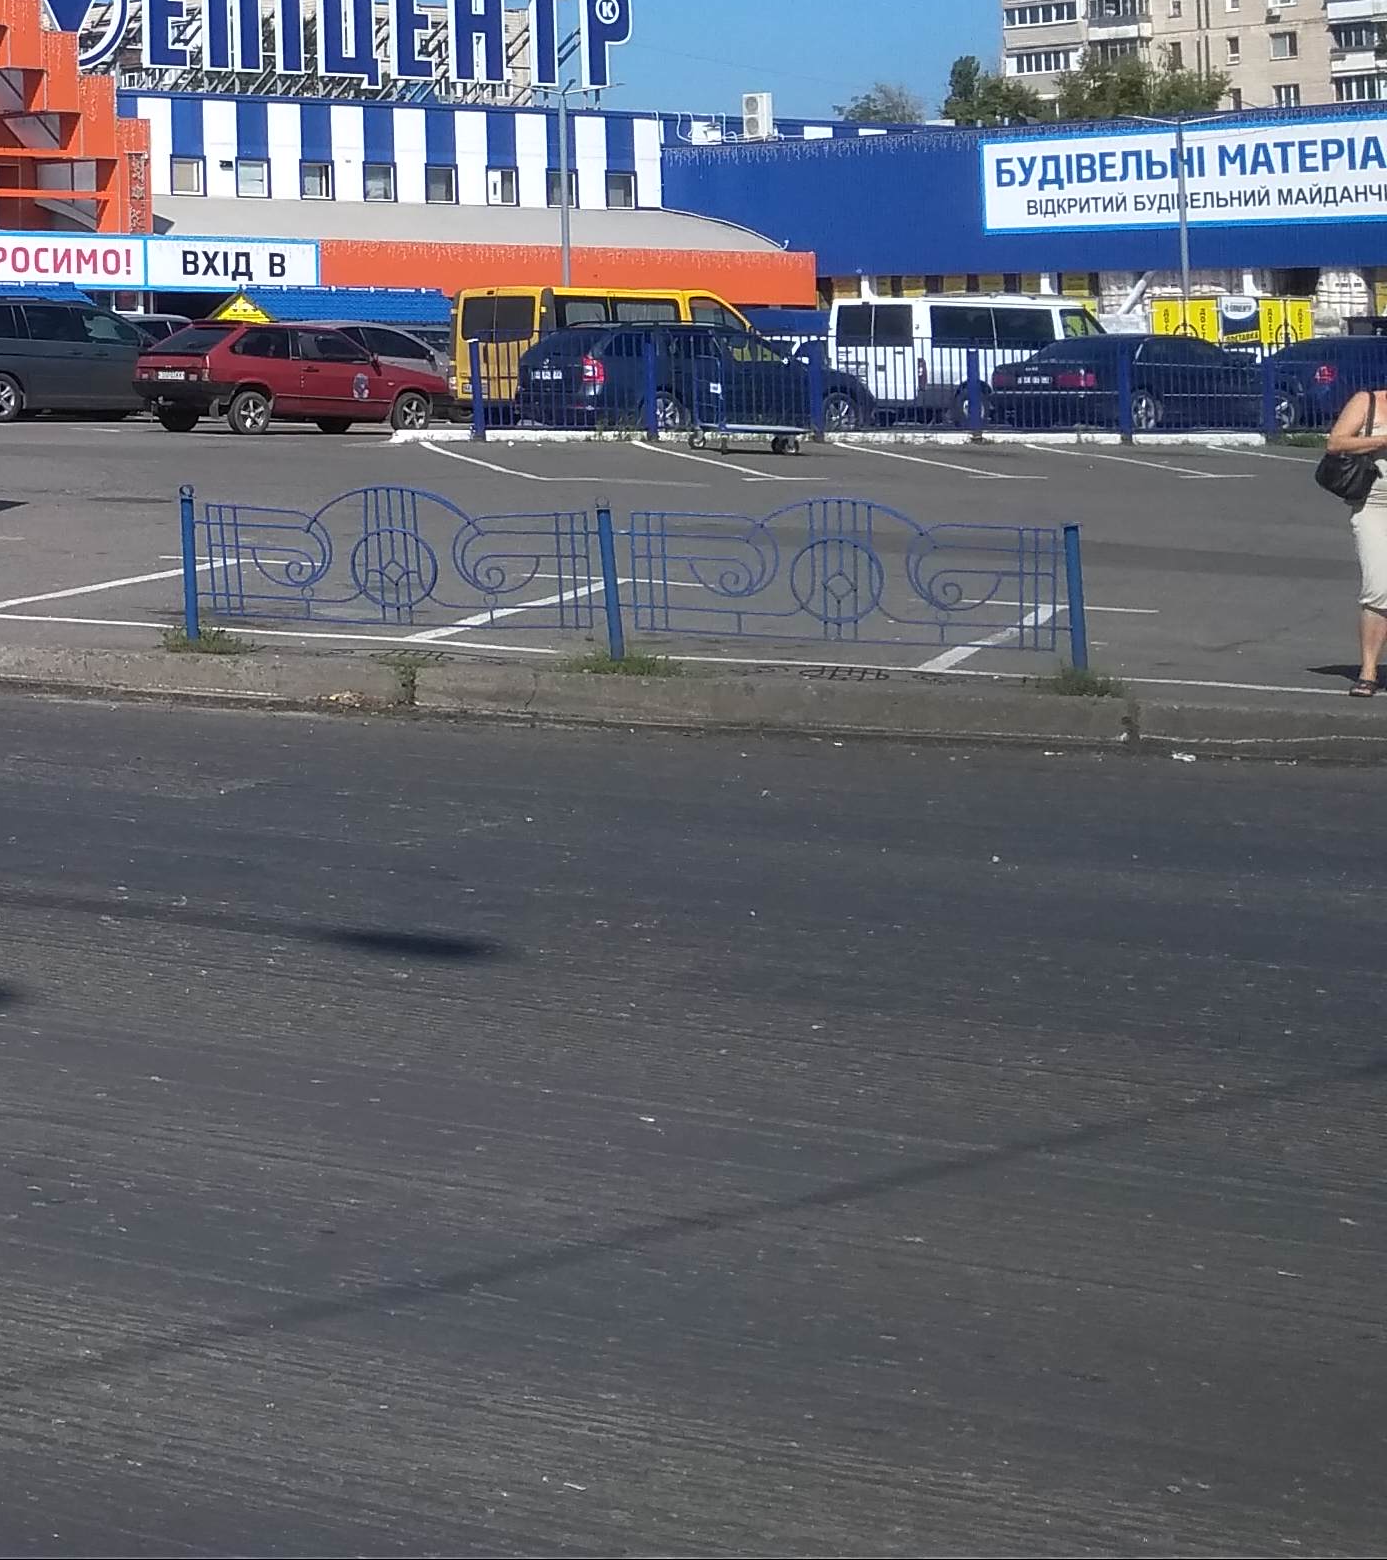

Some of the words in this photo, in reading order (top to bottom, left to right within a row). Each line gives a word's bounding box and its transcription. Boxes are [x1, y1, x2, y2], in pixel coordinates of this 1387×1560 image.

[995, 146, 1206, 192] БУДІВЕЛЬНІ
[1027, 192, 1128, 218] ВІДКРИТИЙ
[1134, 185, 1271, 214] БУДІВЕЛЬНИЙ
[182, 250, 254, 282] ВХІД
[269, 252, 286, 278] В
